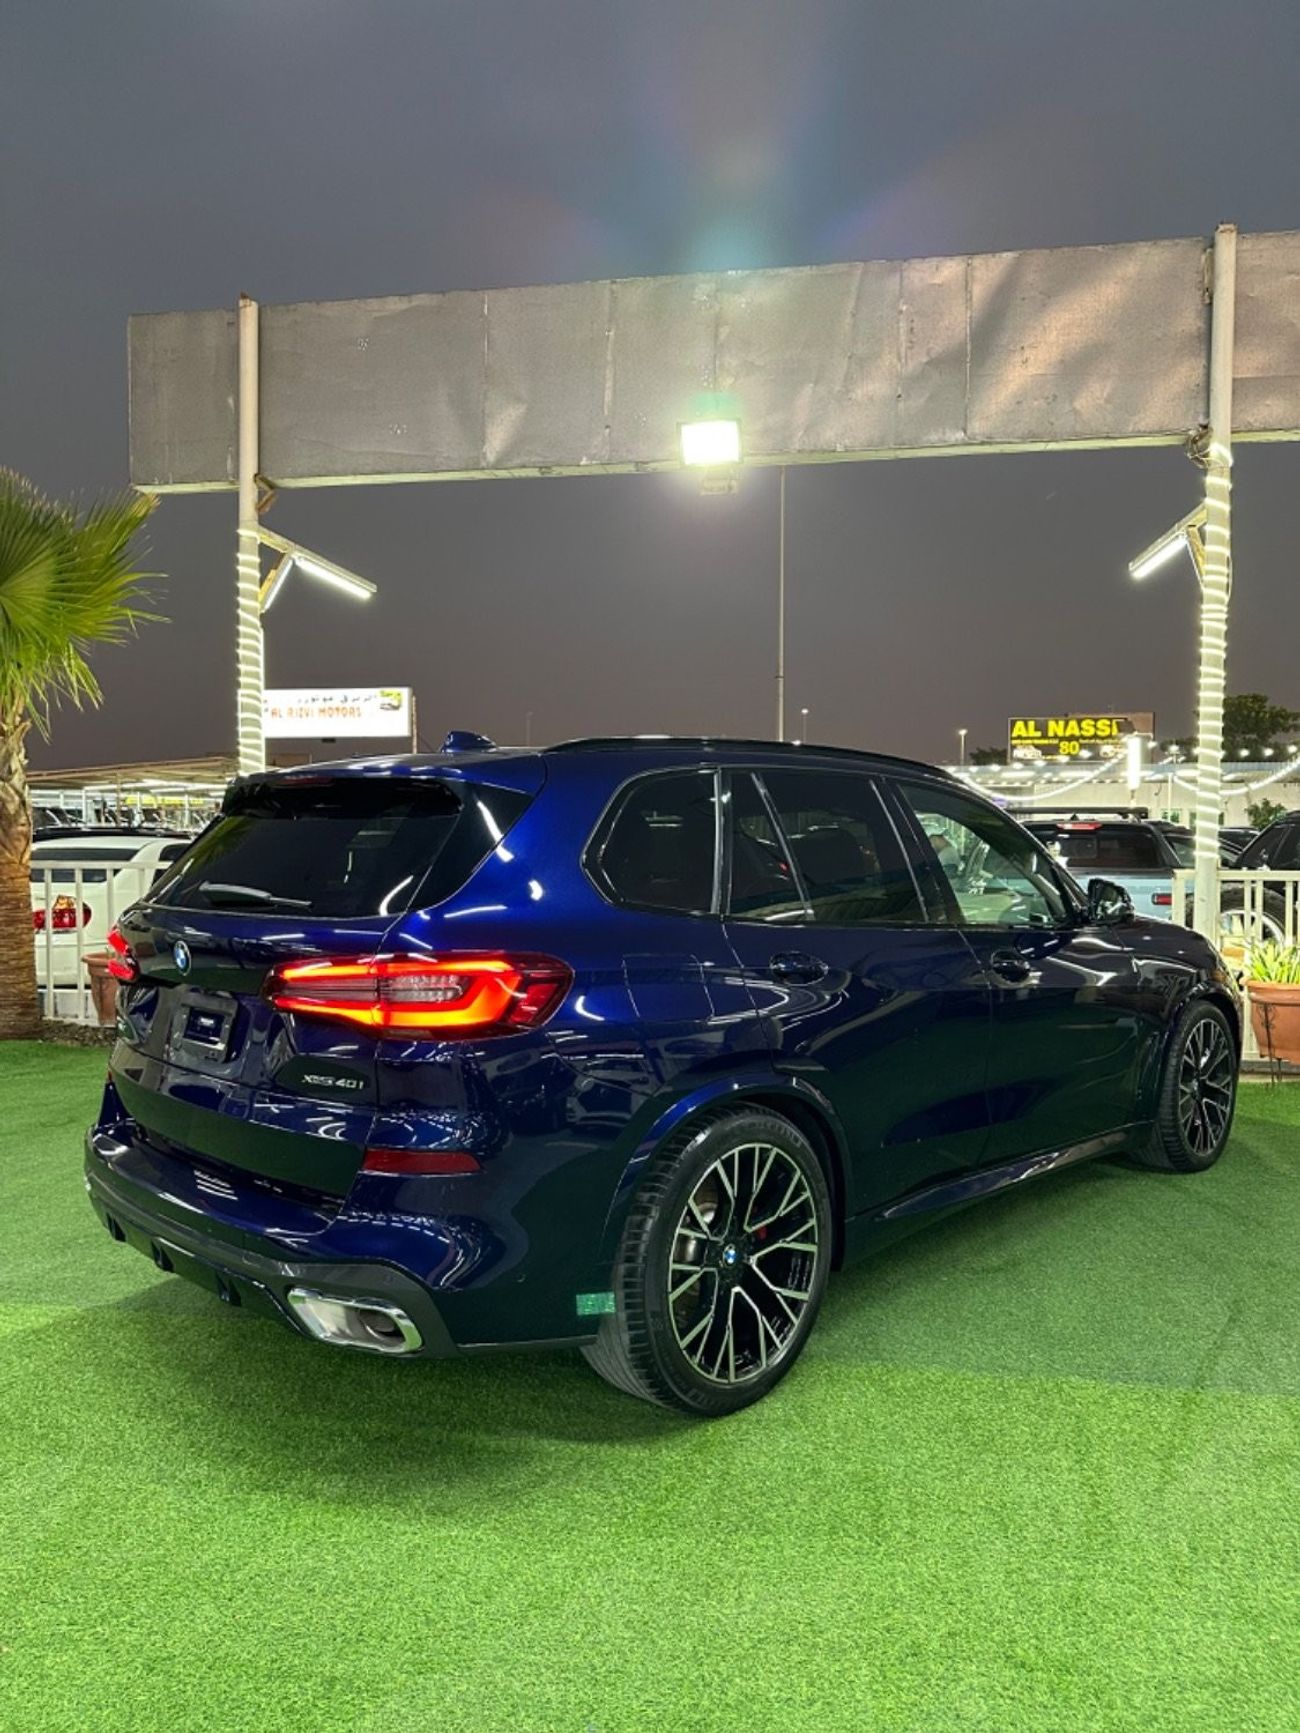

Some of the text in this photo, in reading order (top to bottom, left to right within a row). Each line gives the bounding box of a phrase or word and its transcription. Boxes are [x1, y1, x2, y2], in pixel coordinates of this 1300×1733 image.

[271, 707, 283, 718] AL
[318, 706, 363, 718] MOTORS
[1012, 720, 1042, 737] AL
